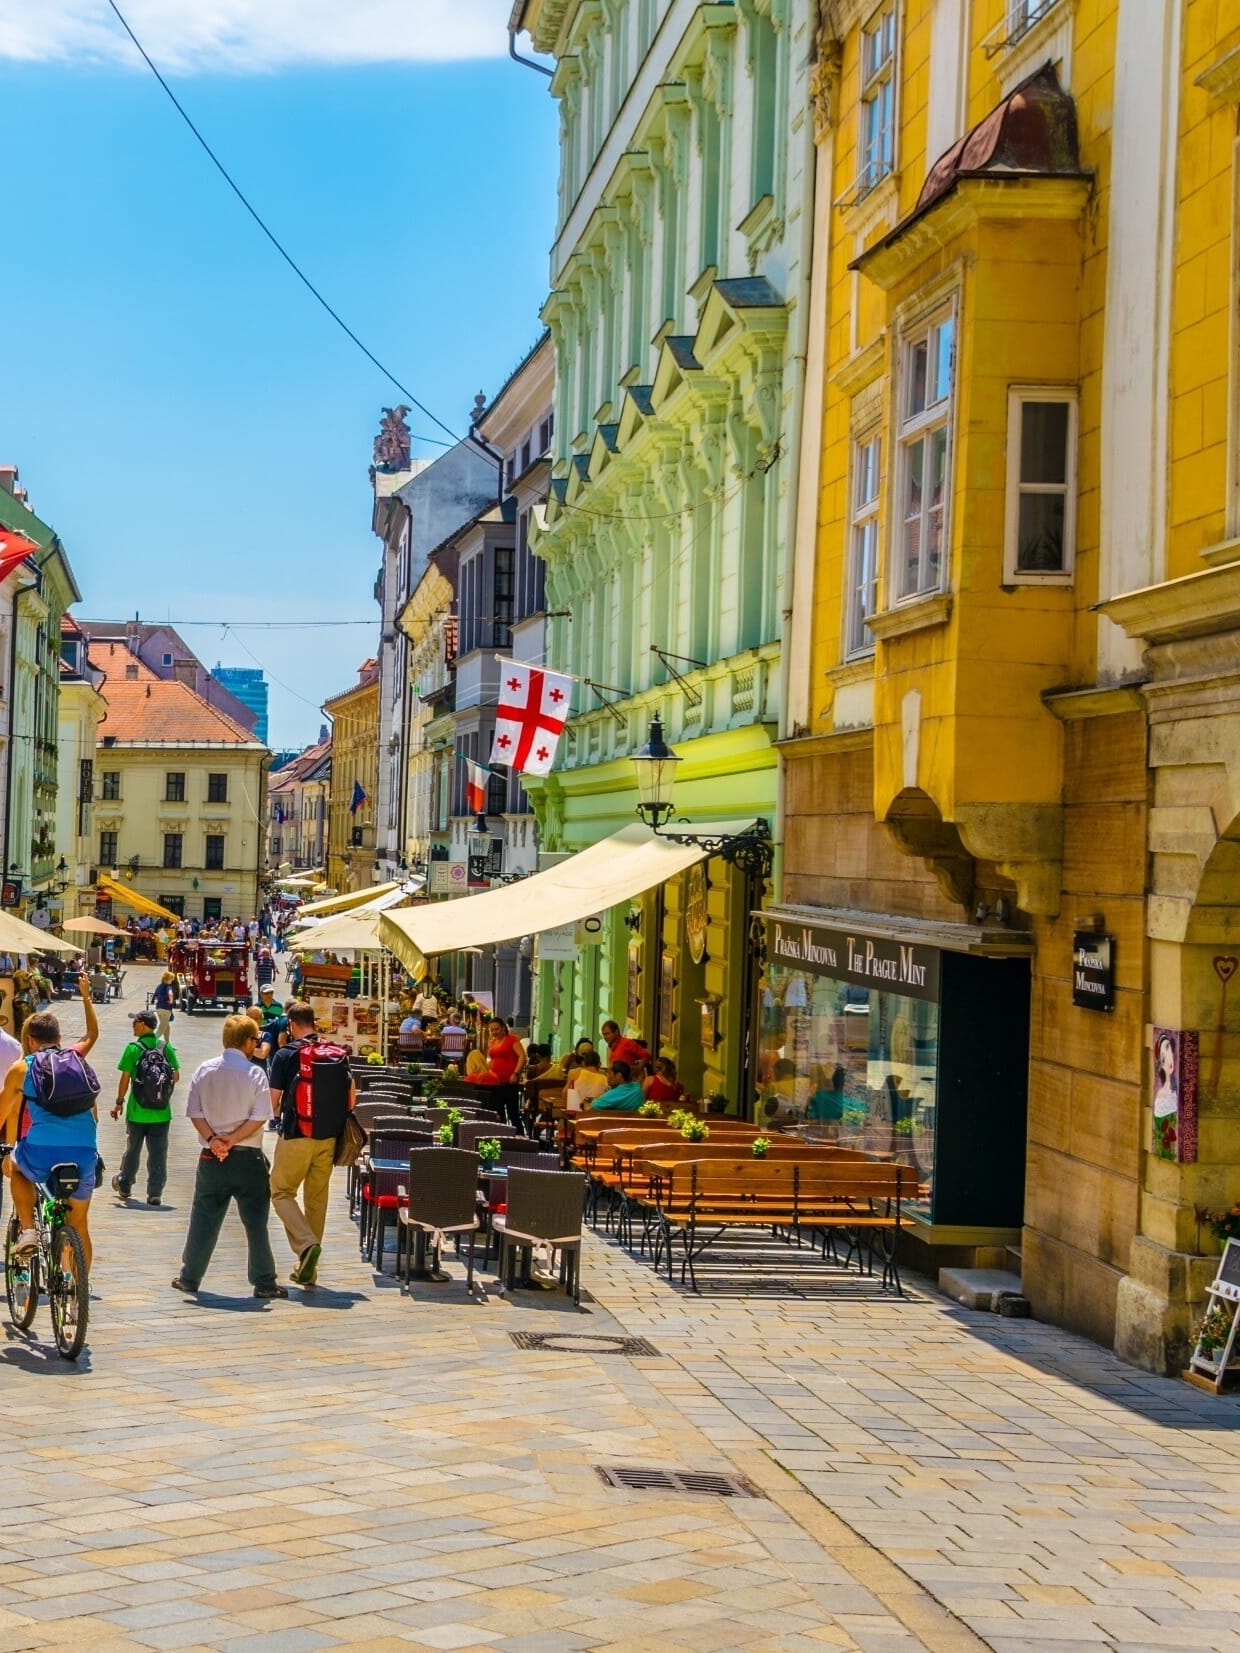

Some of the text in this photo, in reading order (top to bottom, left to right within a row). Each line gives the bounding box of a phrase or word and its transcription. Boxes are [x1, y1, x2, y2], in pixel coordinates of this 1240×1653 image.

[847, 937, 863, 973] THE
[865, 940, 897, 981] PRAGUE
[898, 945, 927, 986] MINT
